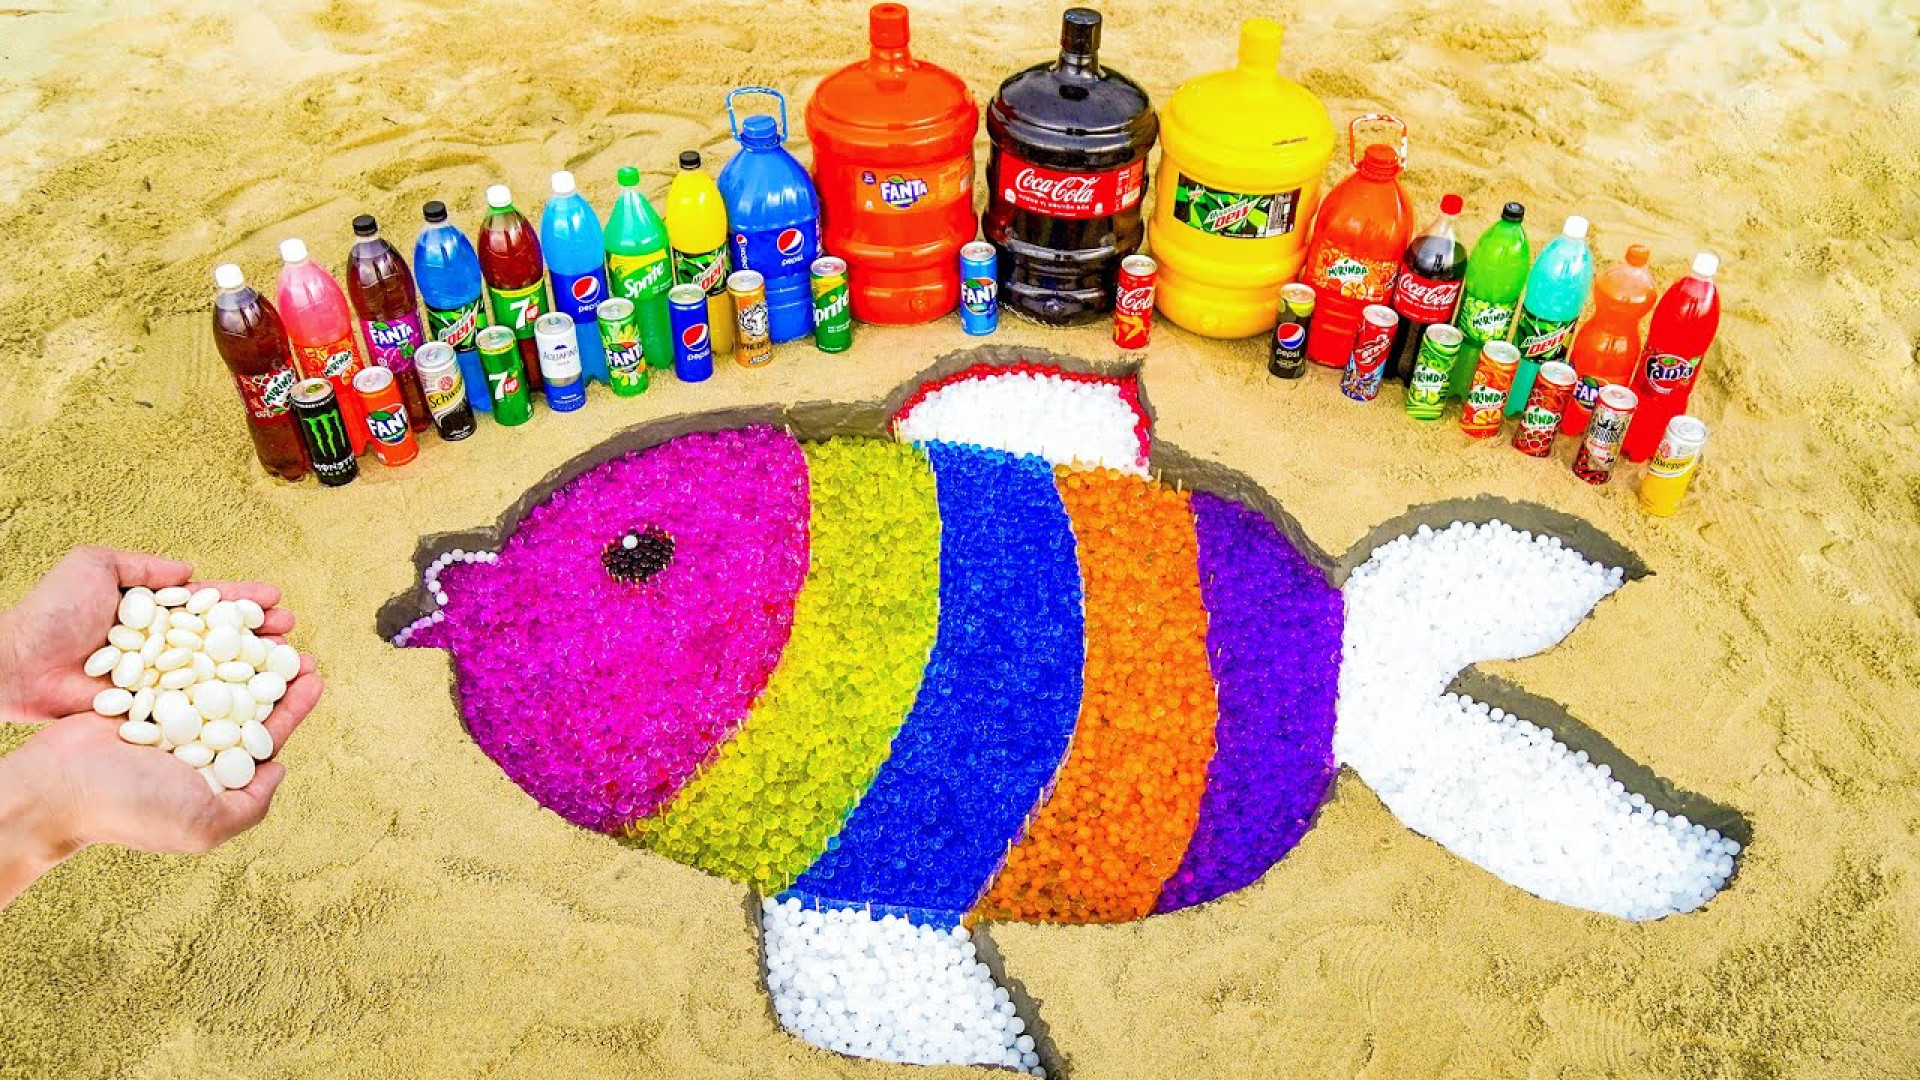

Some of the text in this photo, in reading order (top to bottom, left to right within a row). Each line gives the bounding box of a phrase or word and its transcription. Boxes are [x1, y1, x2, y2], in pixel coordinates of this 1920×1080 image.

[880, 179, 928, 202] FANTA
[1015, 168, 1101, 203] Coca-Cola
[1328, 259, 1368, 276] MIRINDA
[624, 261, 664, 299] Sprite
[1399, 273, 1461, 304] Coca-Cola
[369, 322, 414, 345] FANTA
[1647, 356, 1693, 380] Fanta
